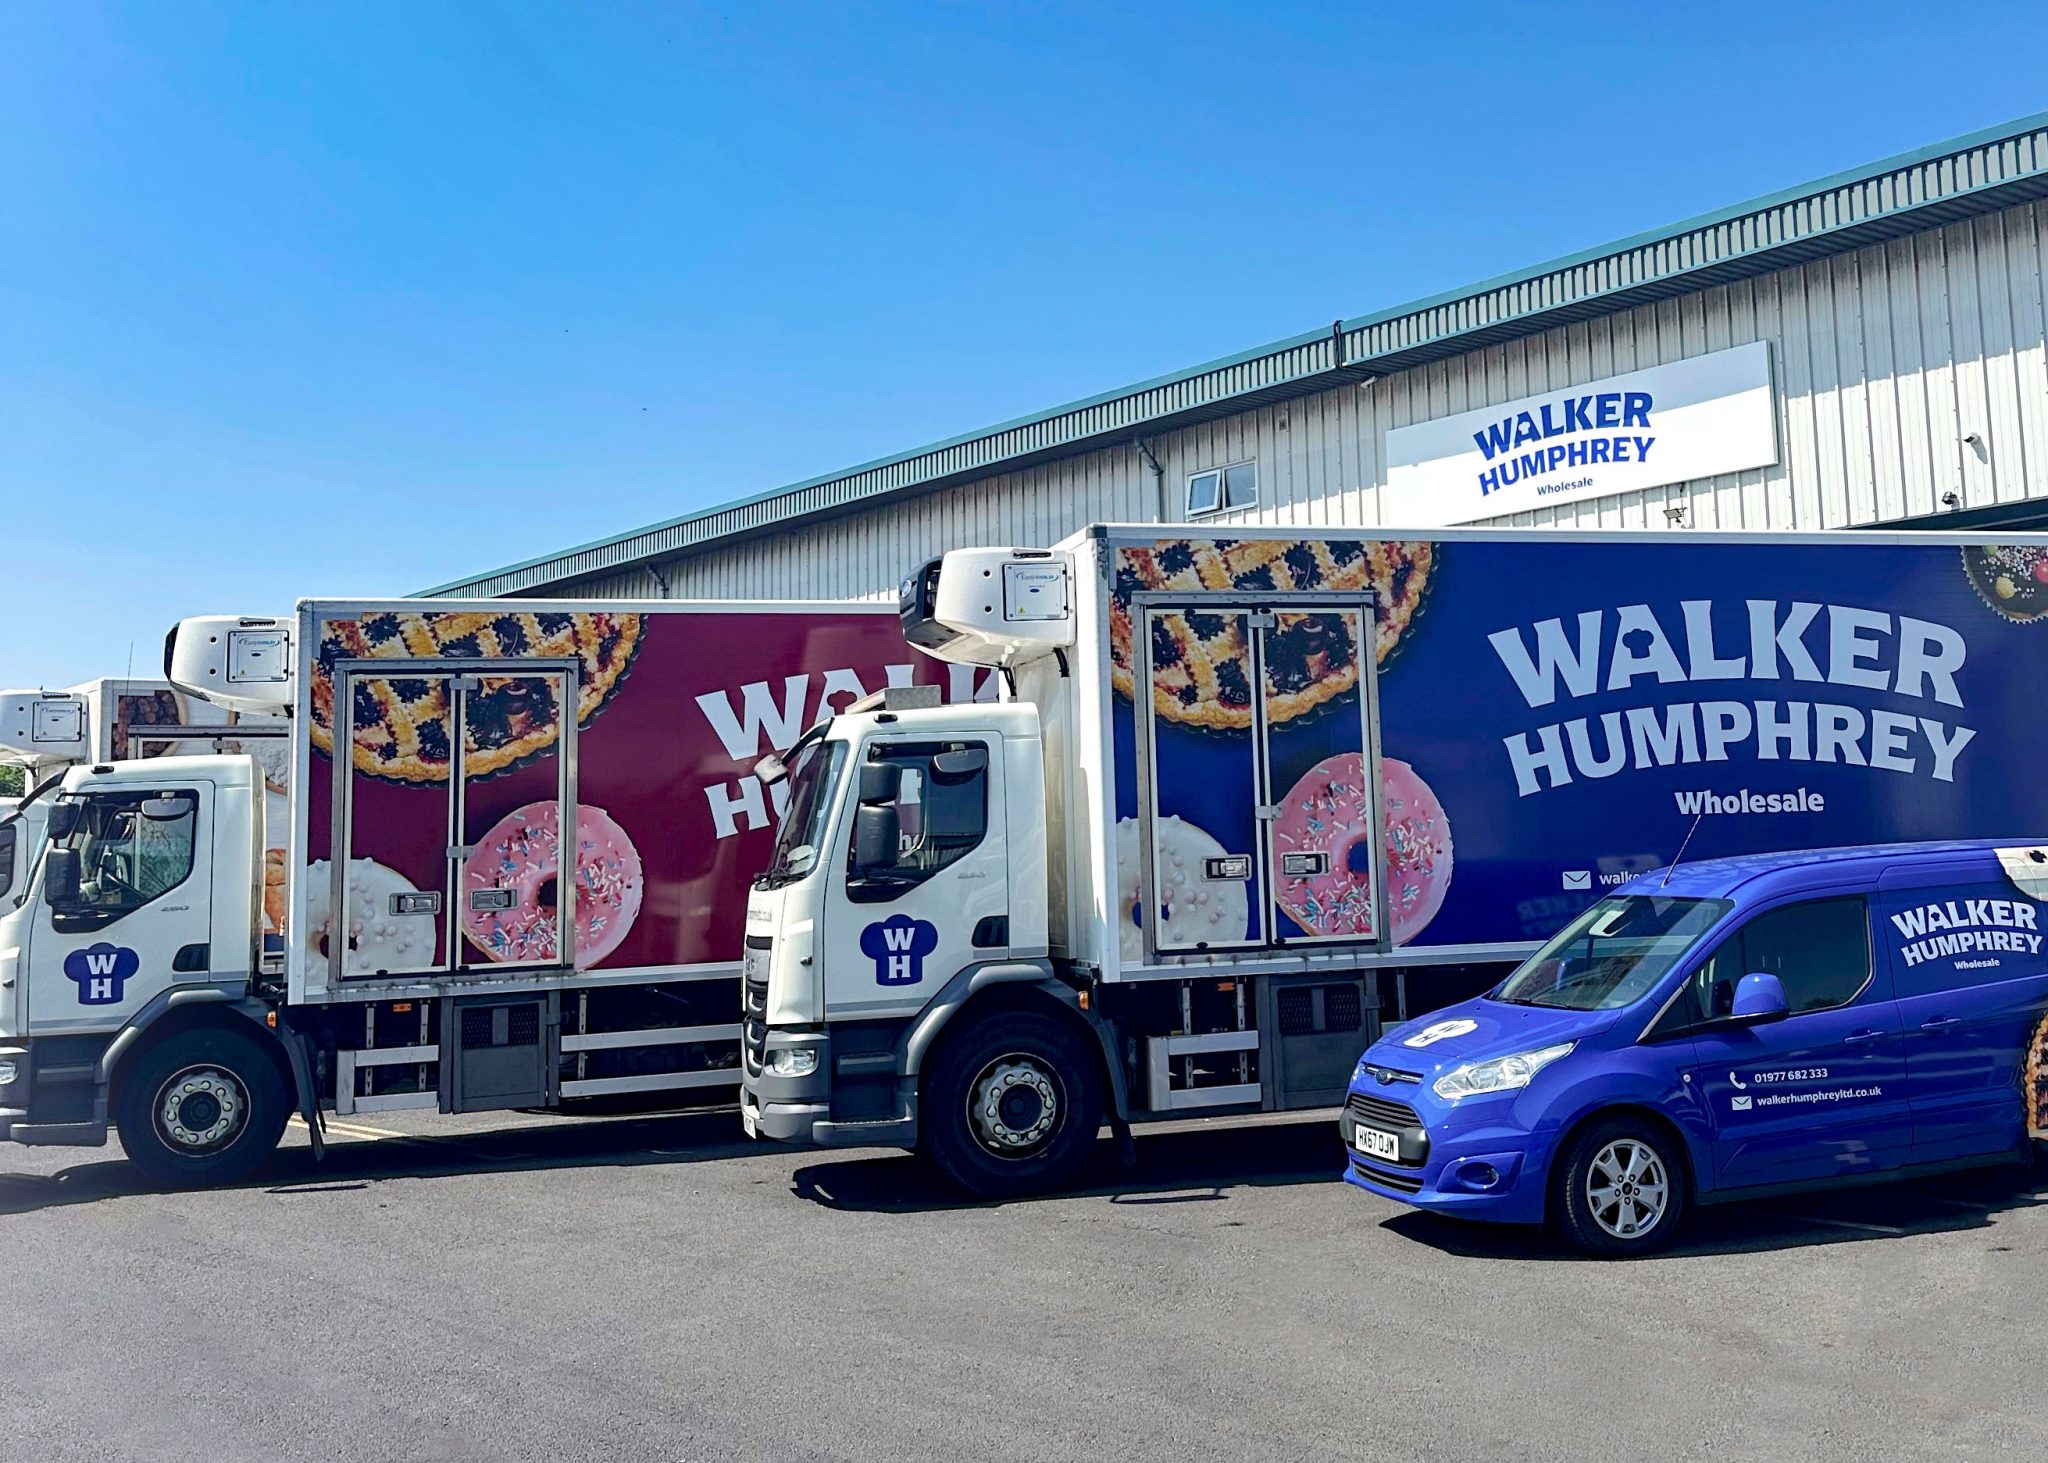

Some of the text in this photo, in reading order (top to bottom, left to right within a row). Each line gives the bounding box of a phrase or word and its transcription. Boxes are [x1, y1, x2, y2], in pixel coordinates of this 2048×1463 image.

[1473, 392, 1653, 461] WALKER
[1478, 437, 1656, 497] HUMPHREY
[1537, 477, 1594, 496] Wholesale
[1488, 599, 1967, 708] WALKER
[1502, 701, 1977, 798] HUMPHREY
[1674, 787, 1825, 815] Wholesale
[1891, 900, 2038, 939] WALKER
[884, 928, 915, 951] W
[1900, 930, 2043, 967] HUMPHREY
[86, 954, 117, 975] W
[888, 955, 910, 979] H
[1954, 958, 2000, 970] Wholesale
[90, 978, 112, 999] H
[1754, 1068, 1828, 1083] 01977 682 333
[1756, 1086, 1882, 1106] walkerhumphreyltd.co.uk
[1359, 1129, 1377, 1149] HX67
